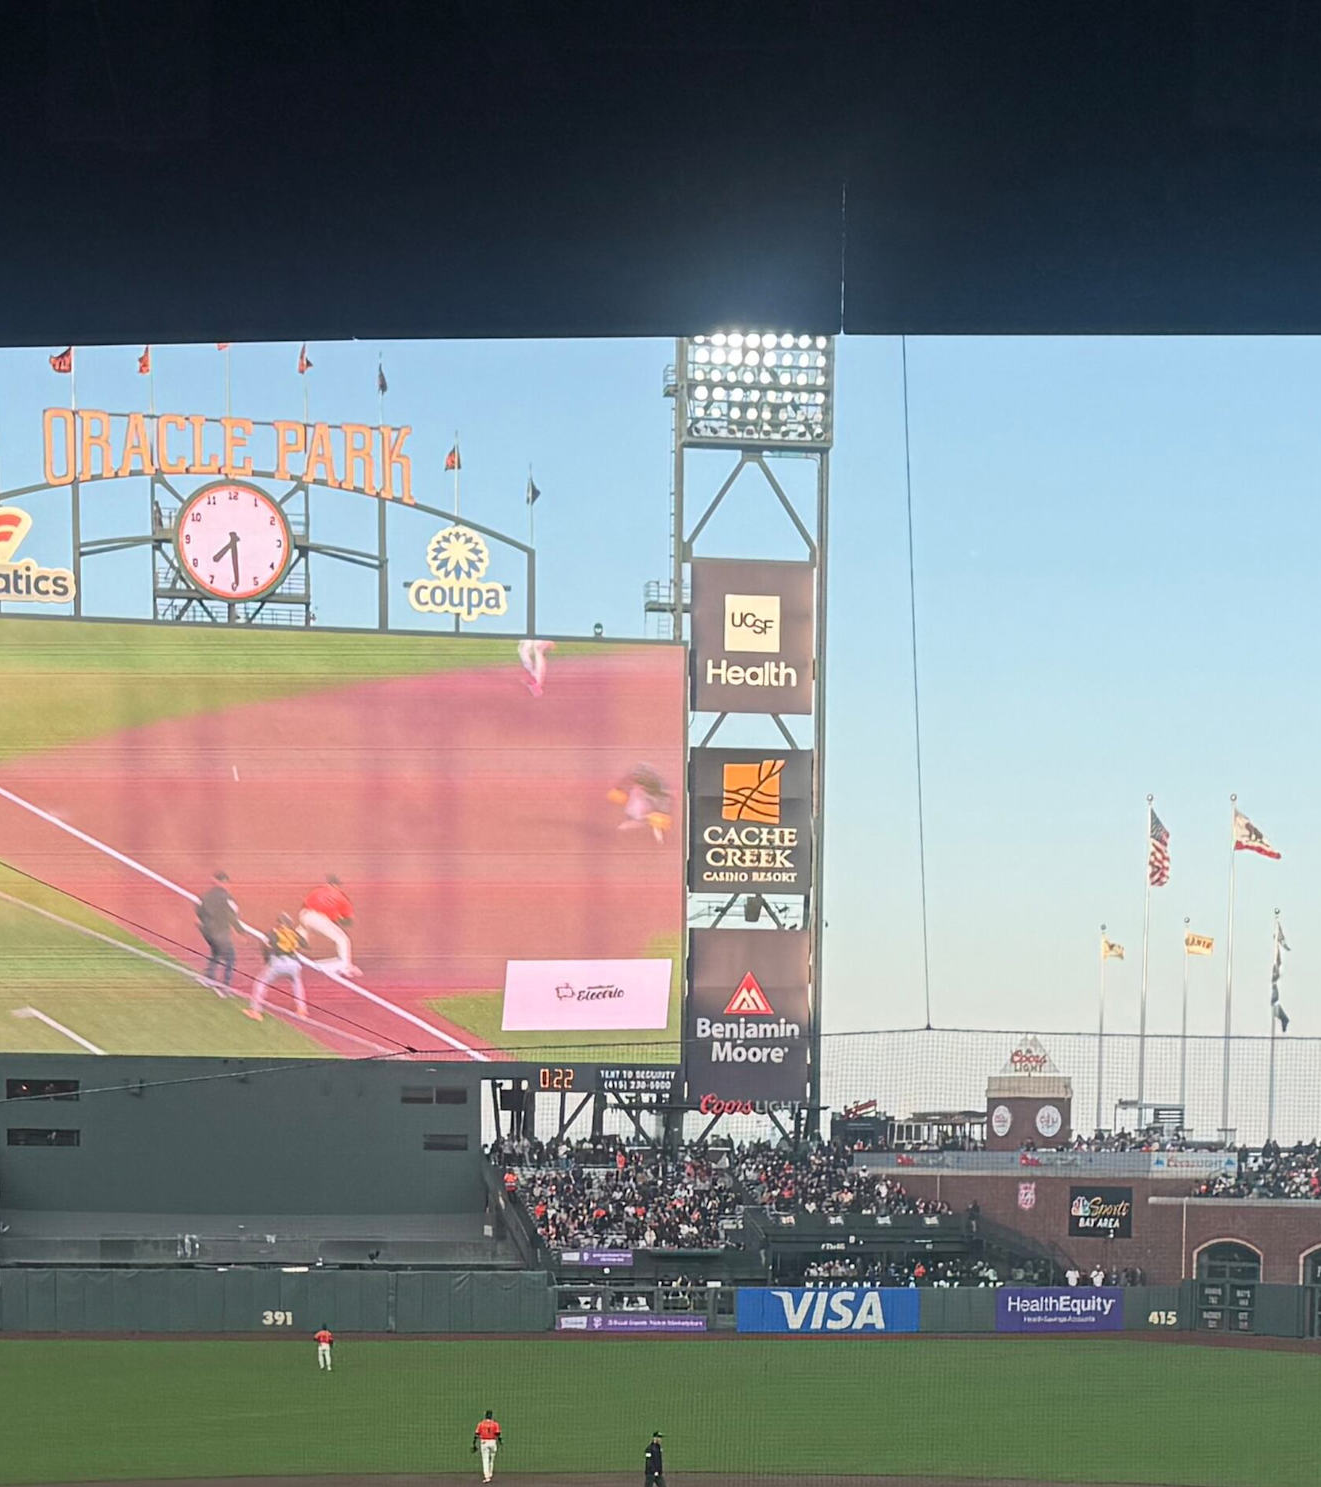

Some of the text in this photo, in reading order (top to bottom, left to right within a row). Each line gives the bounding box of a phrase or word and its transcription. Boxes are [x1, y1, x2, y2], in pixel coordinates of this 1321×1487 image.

[43, 407, 416, 505] ORACLE PARK
[414, 583, 502, 613] coupa
[731, 611, 774, 635] UCSF
[706, 660, 797, 687] Health
[703, 826, 797, 847] CACHE
[706, 848, 794, 868] CREEK
[703, 872, 797, 882] CASINO RESORT
[696, 1018, 799, 1043] Benjamin
[711, 1041, 786, 1063] Moore
[540, 1068, 574, 1089] 0:22
[700, 1093, 802, 1114] Coors LIGHT
[1089, 1196, 1129, 1218] Sports
[1079, 1217, 1120, 1228] BAY AREA
[770, 1291, 886, 1330] VISA
[1008, 1296, 1113, 1315] HealthEquity
[262, 1311, 293, 1326] 391
[1148, 1311, 1177, 1326] 415
